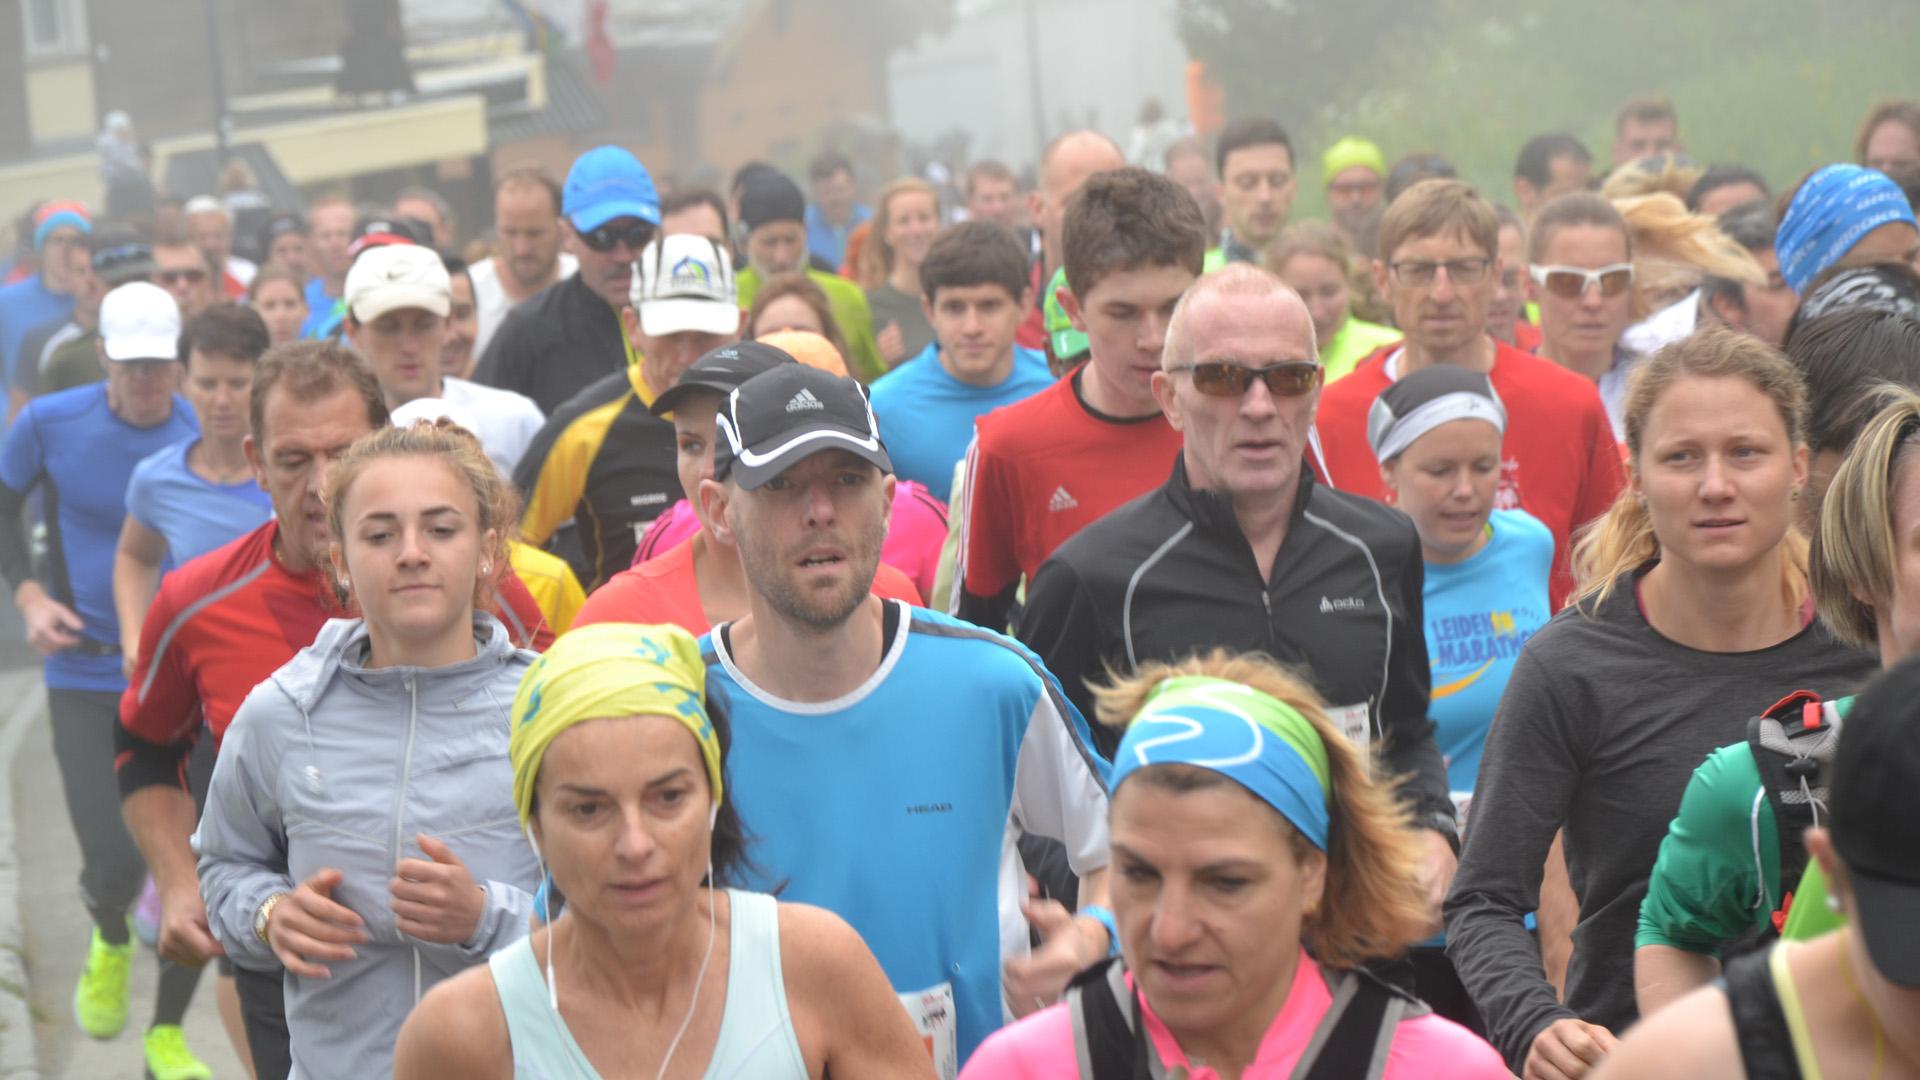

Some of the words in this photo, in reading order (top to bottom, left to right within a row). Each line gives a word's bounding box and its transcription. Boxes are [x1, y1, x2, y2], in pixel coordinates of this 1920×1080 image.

[1431, 612, 1495, 641] LEIDEN
[1439, 629, 1538, 668] MARATH
[905, 802, 953, 816] HEAD
